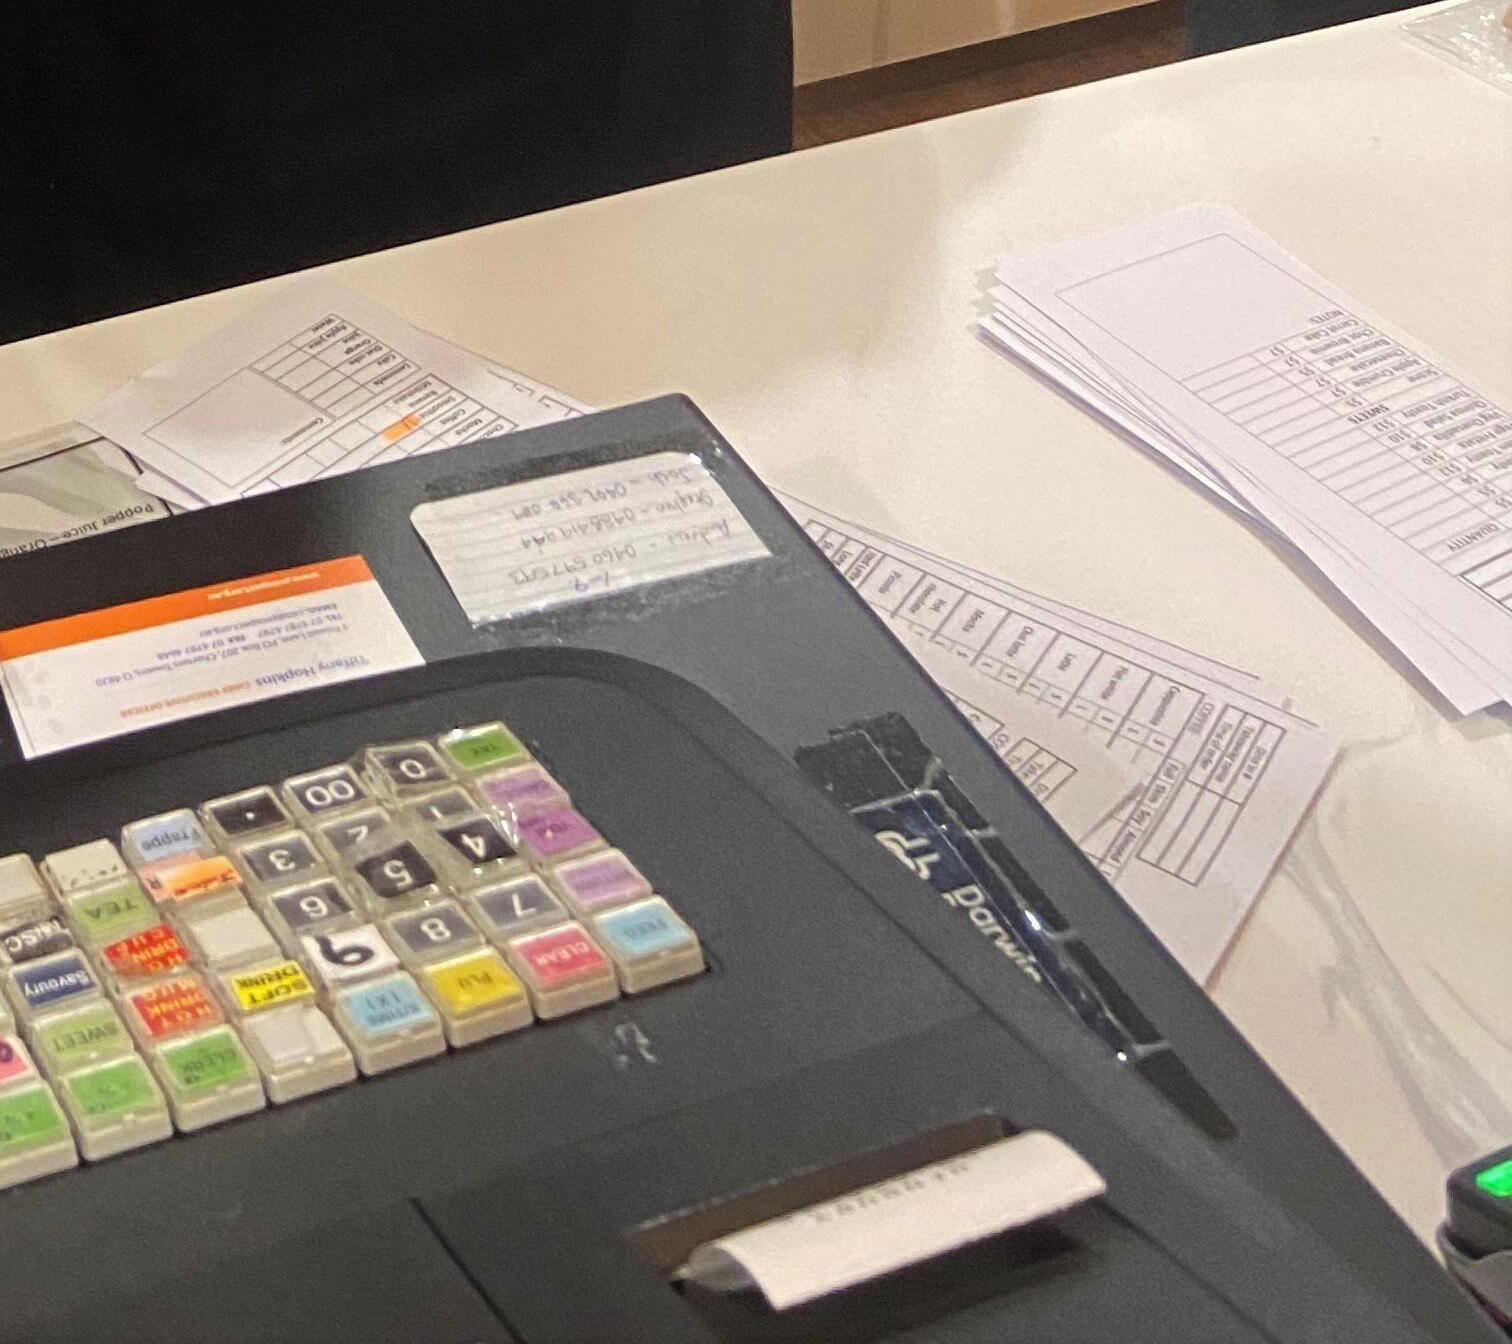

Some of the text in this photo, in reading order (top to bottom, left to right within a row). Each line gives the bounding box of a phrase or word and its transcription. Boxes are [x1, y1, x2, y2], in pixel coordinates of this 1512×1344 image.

[103, 504, 154, 525] Popper
[62, 522, 98, 538] Juice
[256, 666, 315, 686] Hopkins
[398, 756, 426, 780] 0
[302, 778, 356, 808] 00
[460, 830, 489, 860] 4
[266, 847, 298, 872] 3
[380, 857, 414, 888] 5
[83, 896, 136, 924] TEA
[512, 894, 535, 915] 7
[418, 915, 452, 944] 8
[530, 940, 589, 964] CLEAR
[22, 968, 88, 1000] Savoury
[50, 1022, 118, 1052] SWEET
